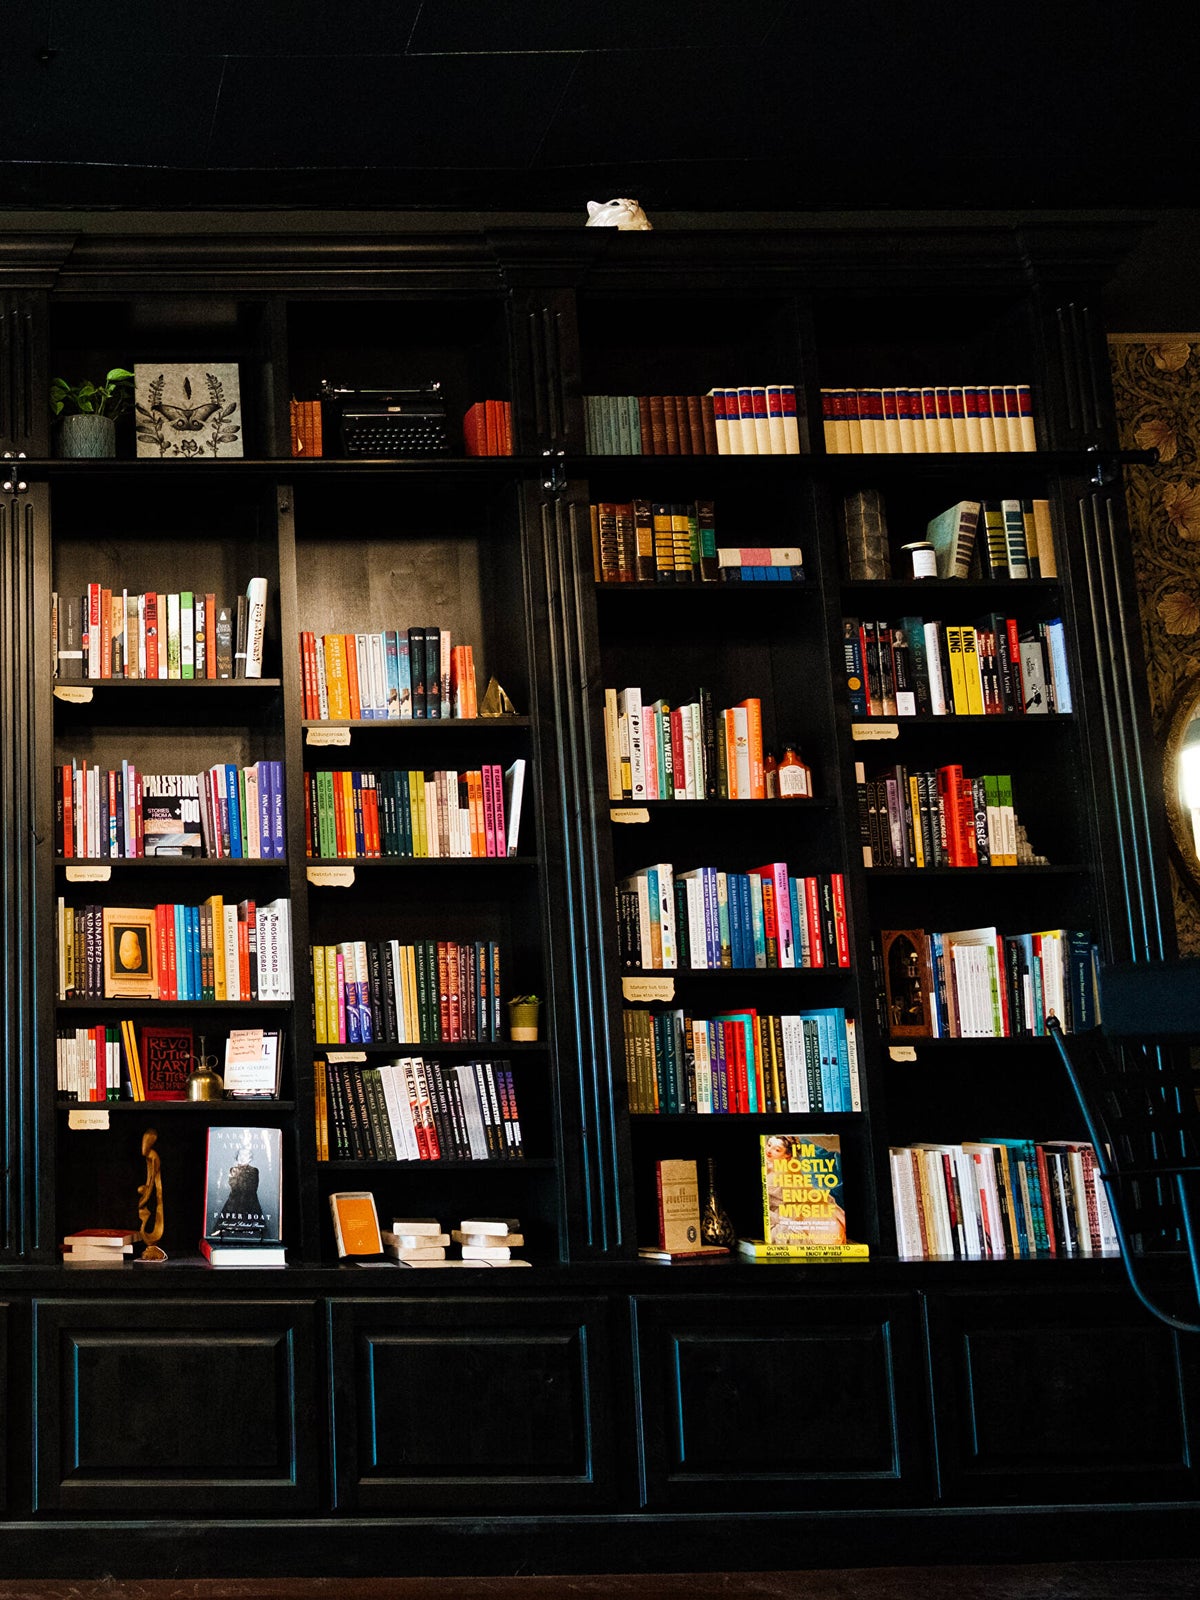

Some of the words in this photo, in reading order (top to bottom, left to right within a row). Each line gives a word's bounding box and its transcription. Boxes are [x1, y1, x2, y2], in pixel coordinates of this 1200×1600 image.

[949, 631, 961, 653] KING
[963, 631, 975, 653] KING
[999, 635, 1009, 673] Background
[1003, 675, 1011, 693] Artist
[142, 776, 198, 797] PALESTINE
[975, 812, 988, 845] Caste
[260, 914, 268, 972] VOROSHILOVGRAD
[150, 1038, 188, 1048] REVO
[150, 1061, 187, 1070] NARY
[405, 1062, 414, 1078] FIRE
[416, 1062, 425, 1078] FIRE
[408, 1080, 417, 1098] EXIT
[419, 1080, 428, 1098] EXIT
[426, 1064, 434, 1090] MYSTERY
[430, 1091, 439, 1112] LIGHTS
[434, 1064, 442, 1090] MYSTERY
[438, 1091, 447, 1112] LIGHTS
[497, 1072, 510, 1119] DEARBORN
[505, 1072, 518, 1119] DEARBORN
[414, 1106, 422, 1129] MORGAN
[425, 1106, 434, 1129] MORGAN
[792, 1144, 815, 1157] I'M
[772, 1159, 835, 1173] MOSTLY
[773, 1174, 812, 1188] HERE
[815, 1174, 838, 1188] TO
[782, 1190, 830, 1203] ENJOY
[779, 1204, 834, 1218] MYSELF
